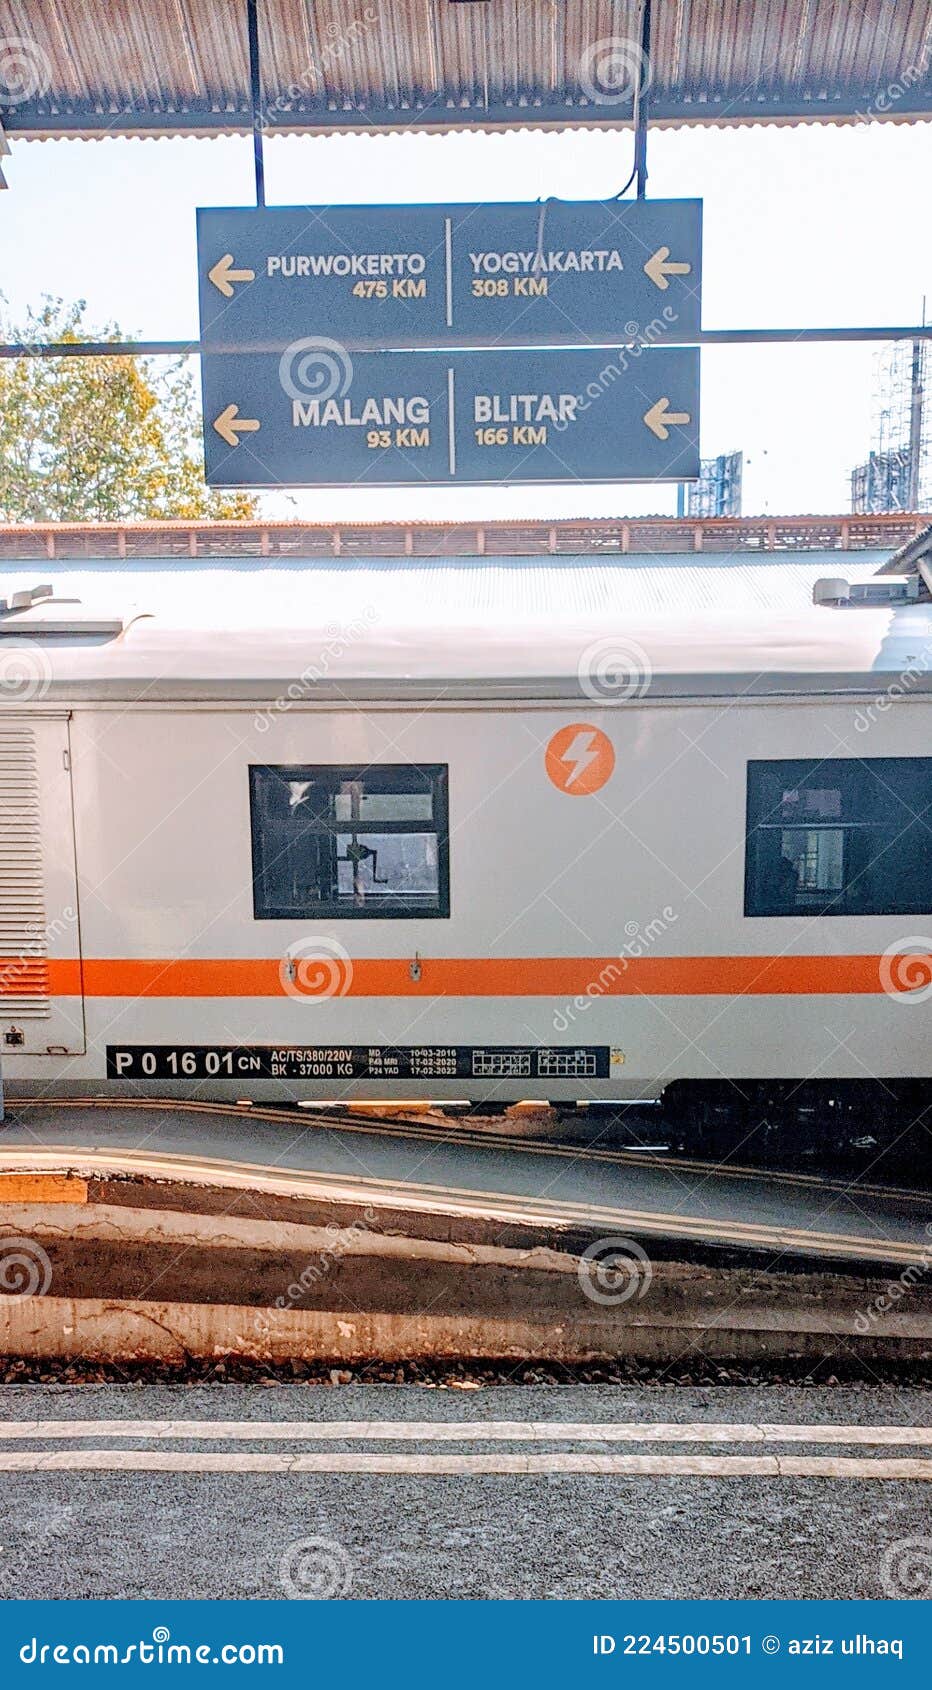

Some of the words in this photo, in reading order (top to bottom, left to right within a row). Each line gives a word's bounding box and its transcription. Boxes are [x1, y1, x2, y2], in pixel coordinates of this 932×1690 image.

[267, 253, 426, 276] PURWOKERTO
[469, 250, 624, 273] YOGYAKARTA
[352, 280, 388, 299] 475
[392, 280, 426, 298] KM
[472, 279, 508, 297] 308
[514, 277, 548, 297] KM
[292, 396, 430, 427] MALANG
[474, 394, 577, 423] BLITAR
[367, 431, 391, 449] 93
[396, 430, 430, 448] KM
[475, 428, 508, 445] 166
[514, 426, 547, 445] KM
[116, 1053, 133, 1075] P
[142, 1053, 157, 1075] 0
[166, 1053, 197, 1074] 16
[205, 1053, 233, 1074] 01
[238, 1056, 261, 1071] CN
[271, 1050, 353, 1062] AC/TS/380/220V
[271, 1065, 287, 1075] BK
[300, 1065, 332, 1075] 37000
[337, 1064, 354, 1075] KG
